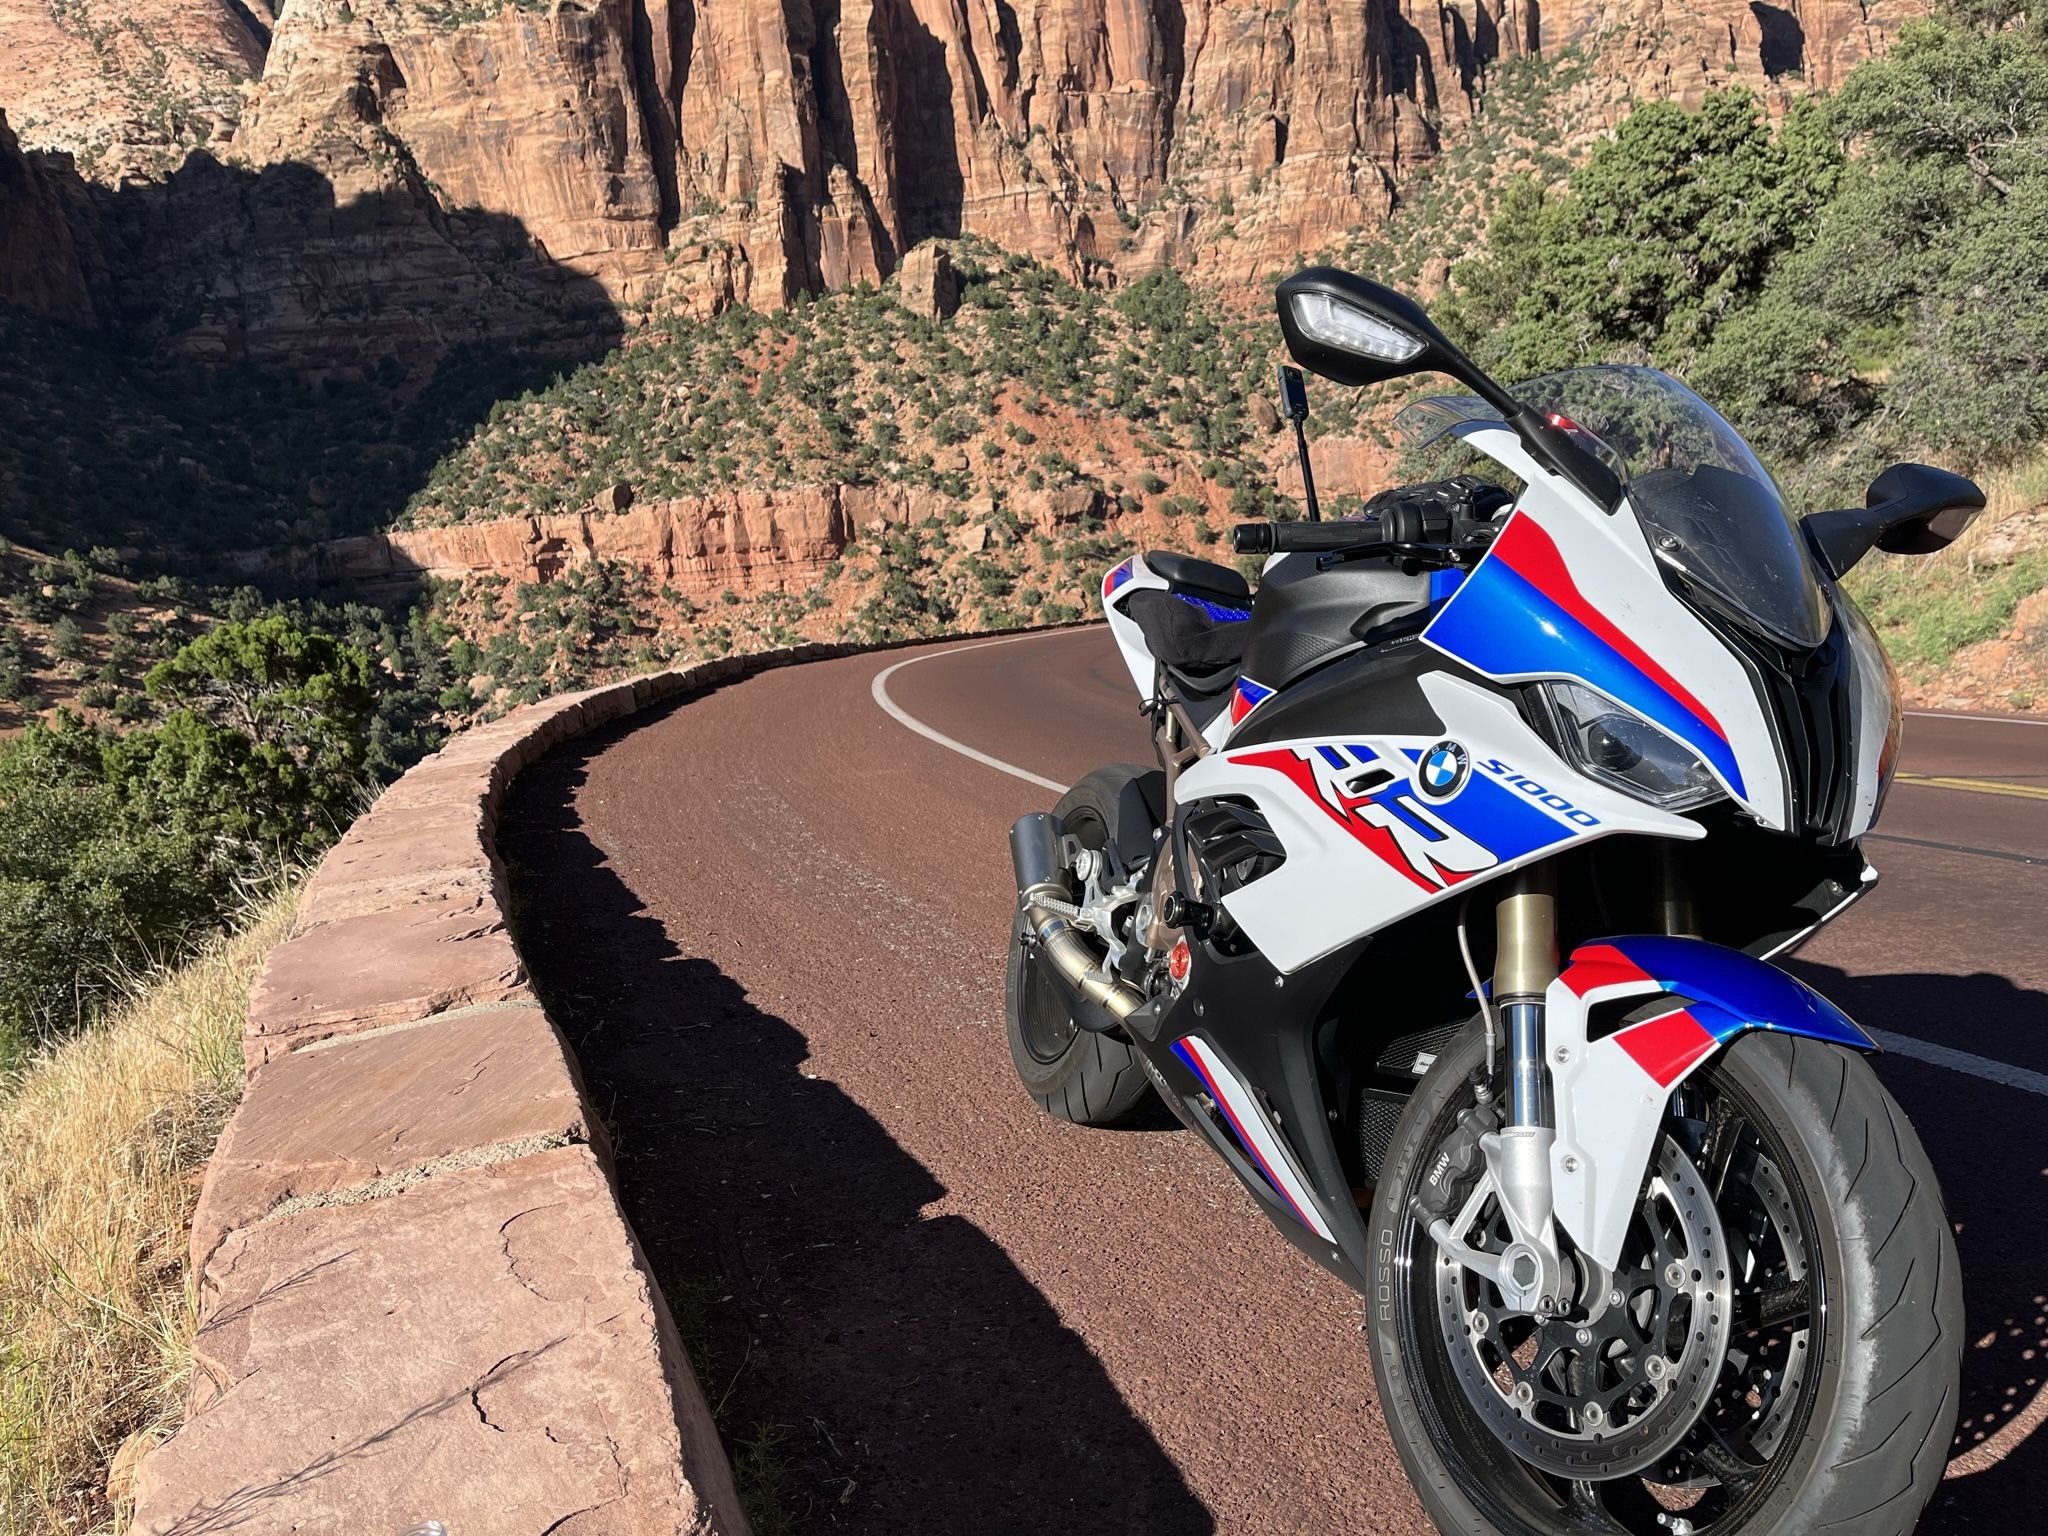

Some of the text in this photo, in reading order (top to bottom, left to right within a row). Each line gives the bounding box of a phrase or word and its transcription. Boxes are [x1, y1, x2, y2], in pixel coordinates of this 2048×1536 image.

[1431, 742, 1468, 766] BMW
[1476, 758, 1602, 827] S1000
[1428, 1151, 1451, 1187] BMW
[1378, 1229, 1394, 1321] ROSSO
